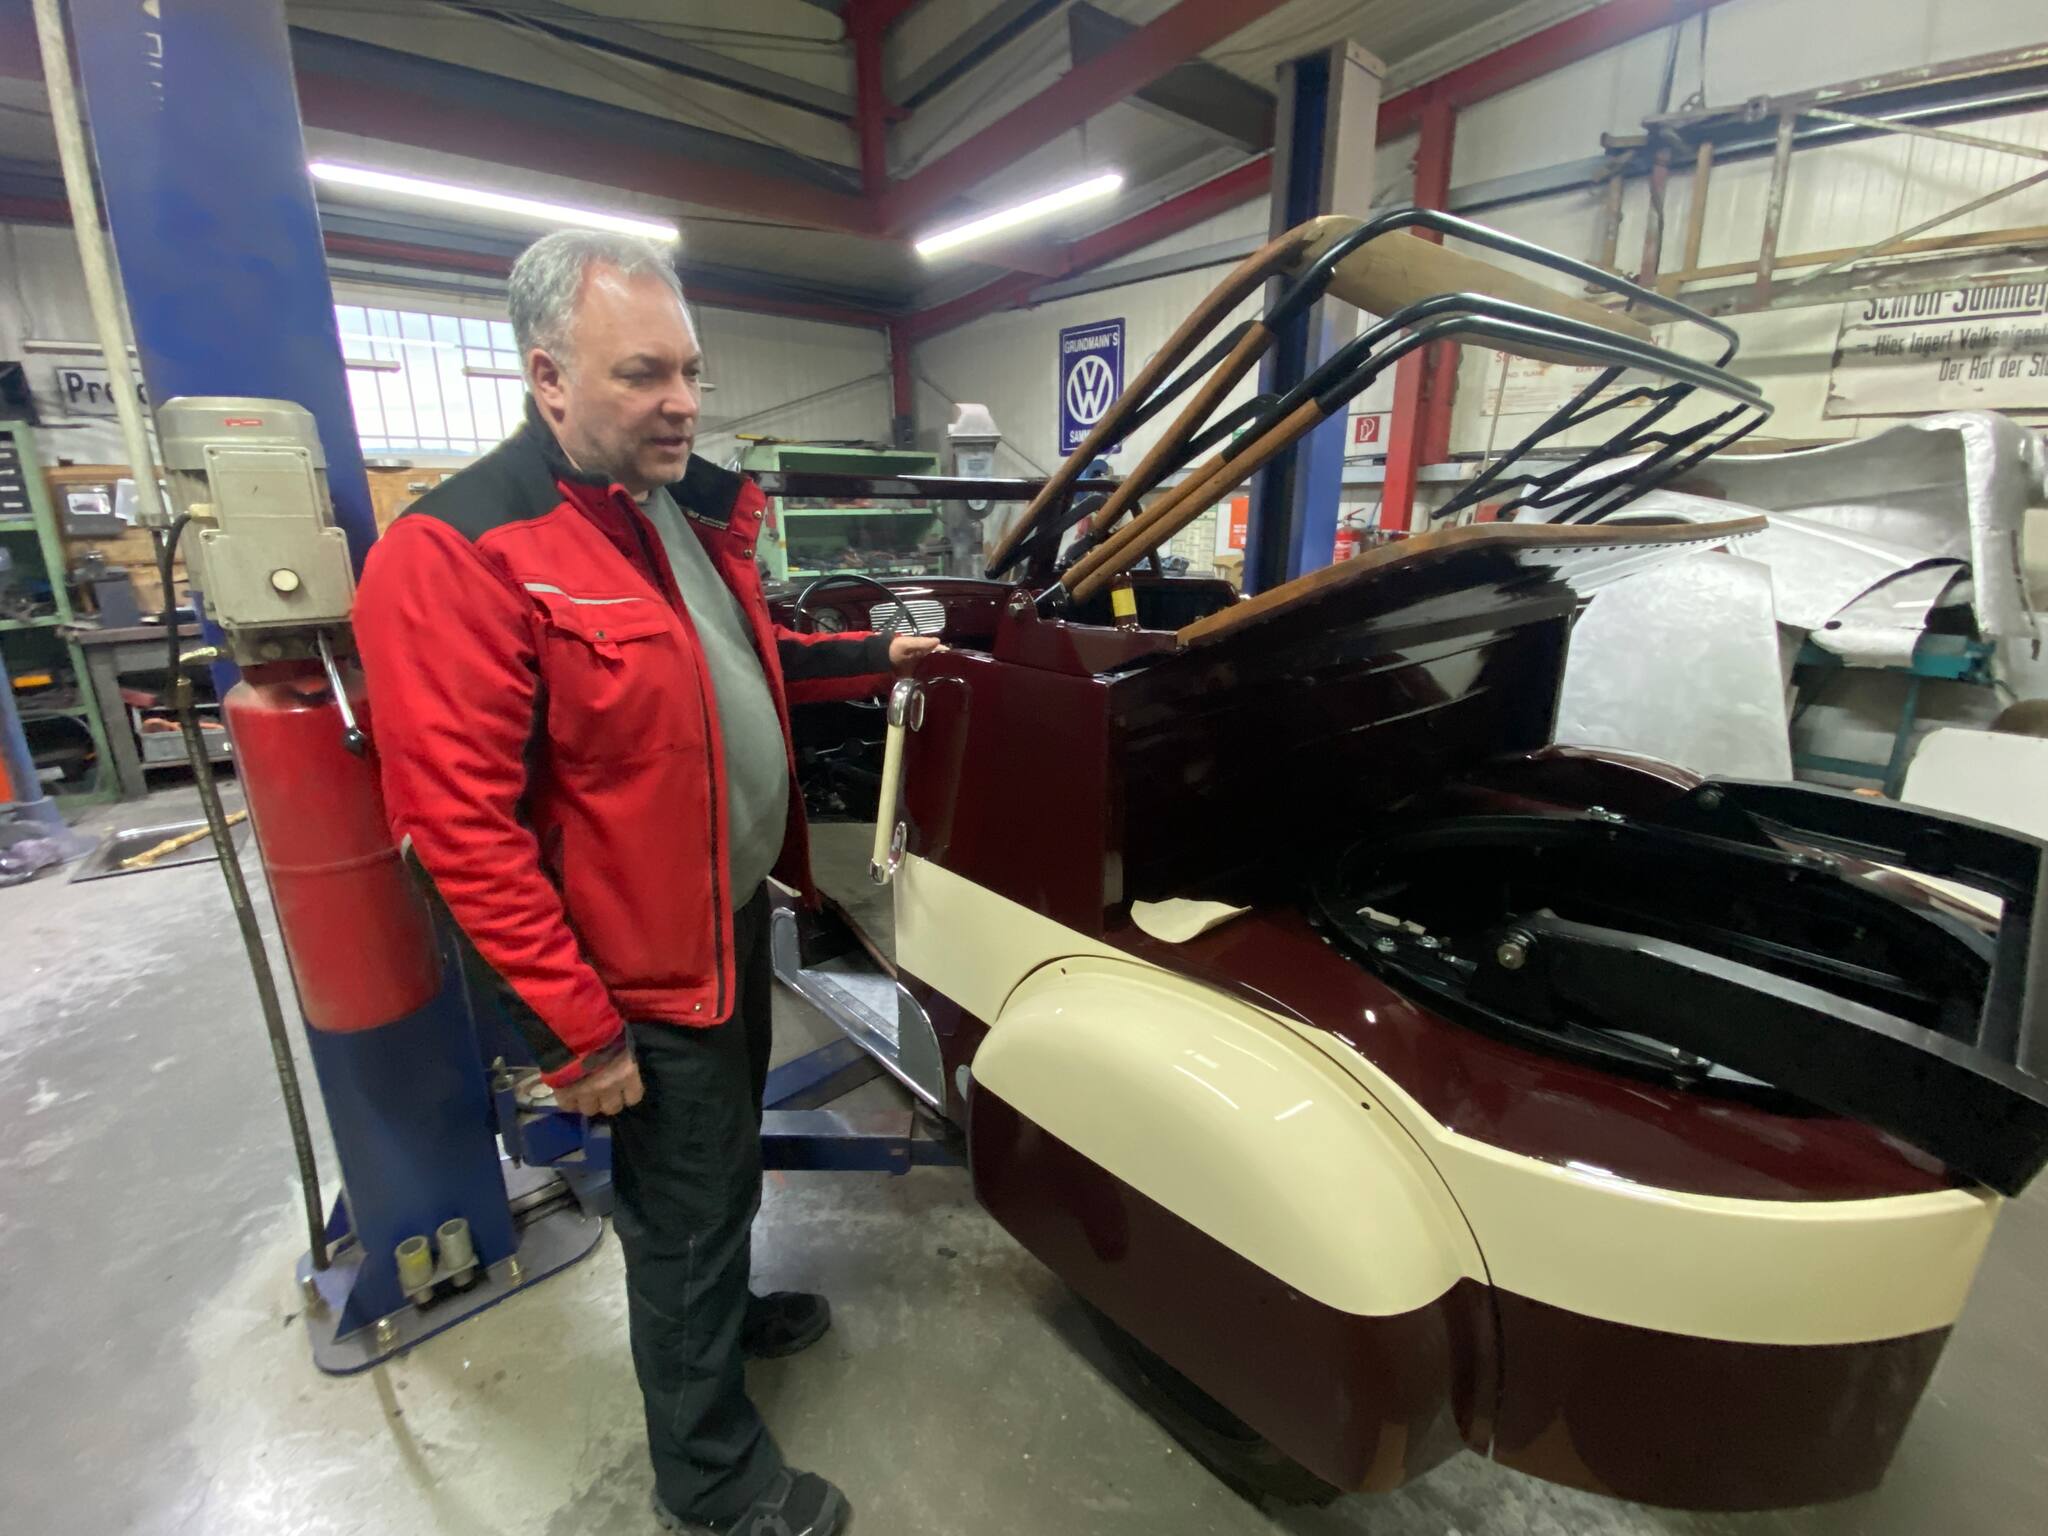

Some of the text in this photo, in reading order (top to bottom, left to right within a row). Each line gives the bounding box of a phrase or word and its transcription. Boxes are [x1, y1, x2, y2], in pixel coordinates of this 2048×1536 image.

[1874, 334, 1905, 356] Hier
[1939, 351, 2048, 381] Der Rat der St
